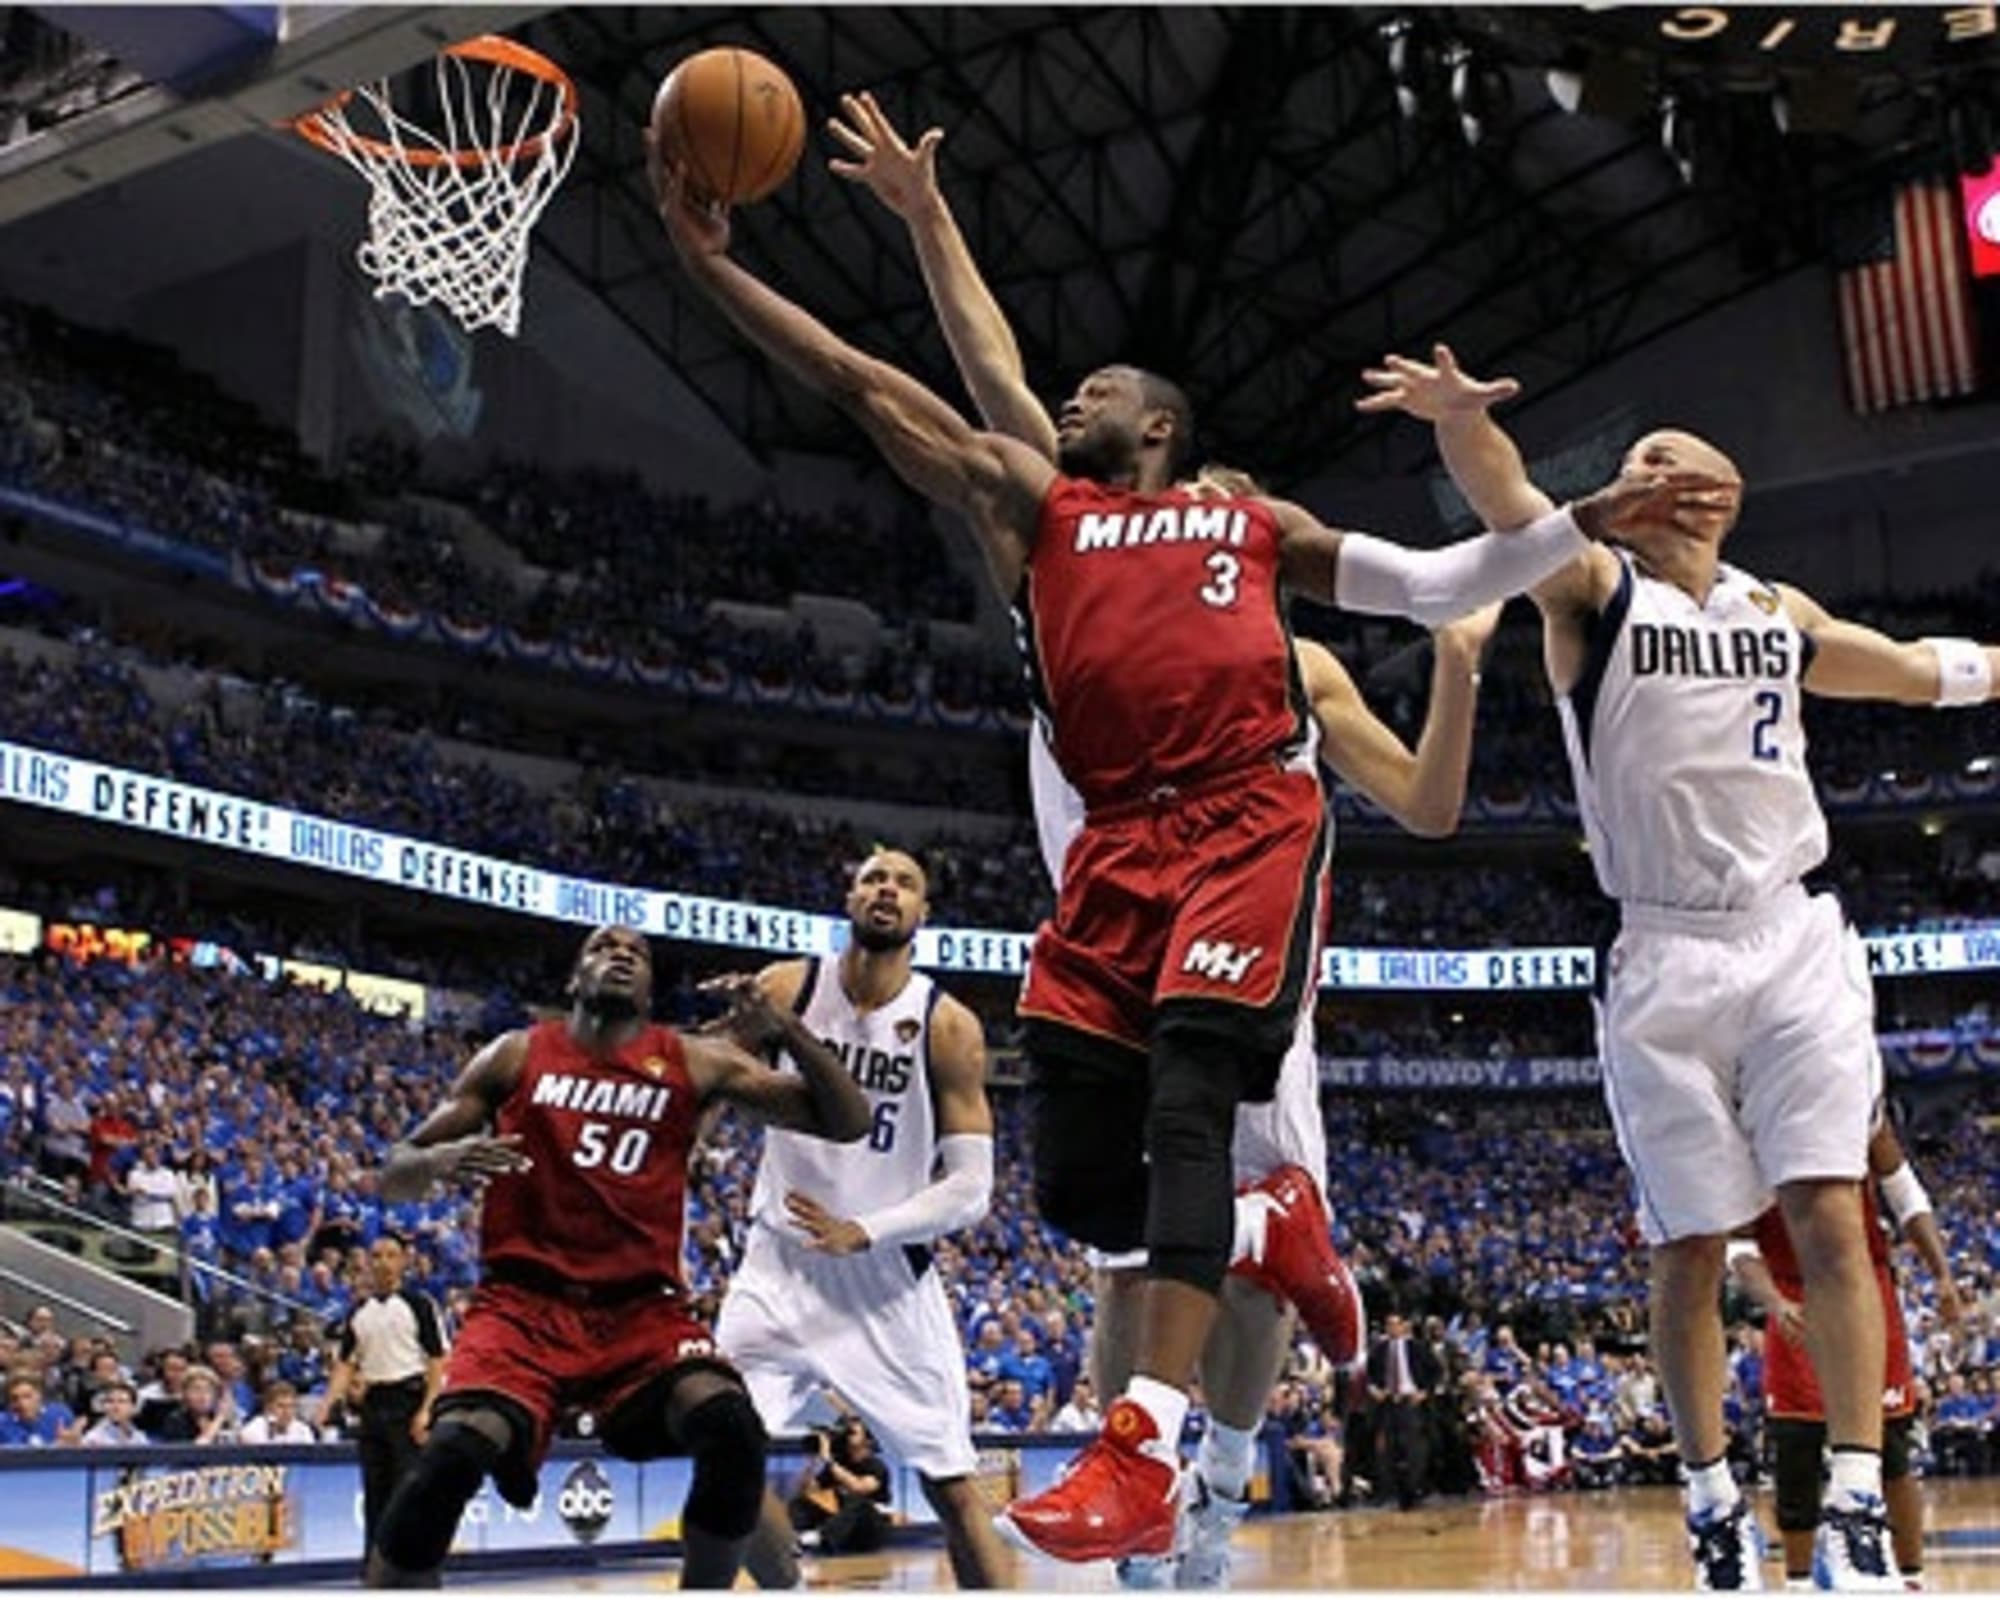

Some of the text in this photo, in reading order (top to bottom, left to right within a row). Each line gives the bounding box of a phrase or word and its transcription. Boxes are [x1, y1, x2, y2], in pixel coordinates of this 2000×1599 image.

[1075, 506, 1248, 551] MIAMI
[1202, 552, 1240, 607] 3
[1631, 624, 1788, 679] DALLAS
[1753, 691, 1782, 760] 2
[94, 773, 270, 849] DEFENSE!
[401, 846, 541, 908] DEFENSE!
[665, 900, 813, 950] DEFENSE!
[532, 1074, 671, 1121] MIAMI
[572, 1122, 649, 1175] 50
[869, 1102, 899, 1152] 6
[92, 1466, 286, 1536] EXPEDITION
[559, 1479, 614, 1517] abc
